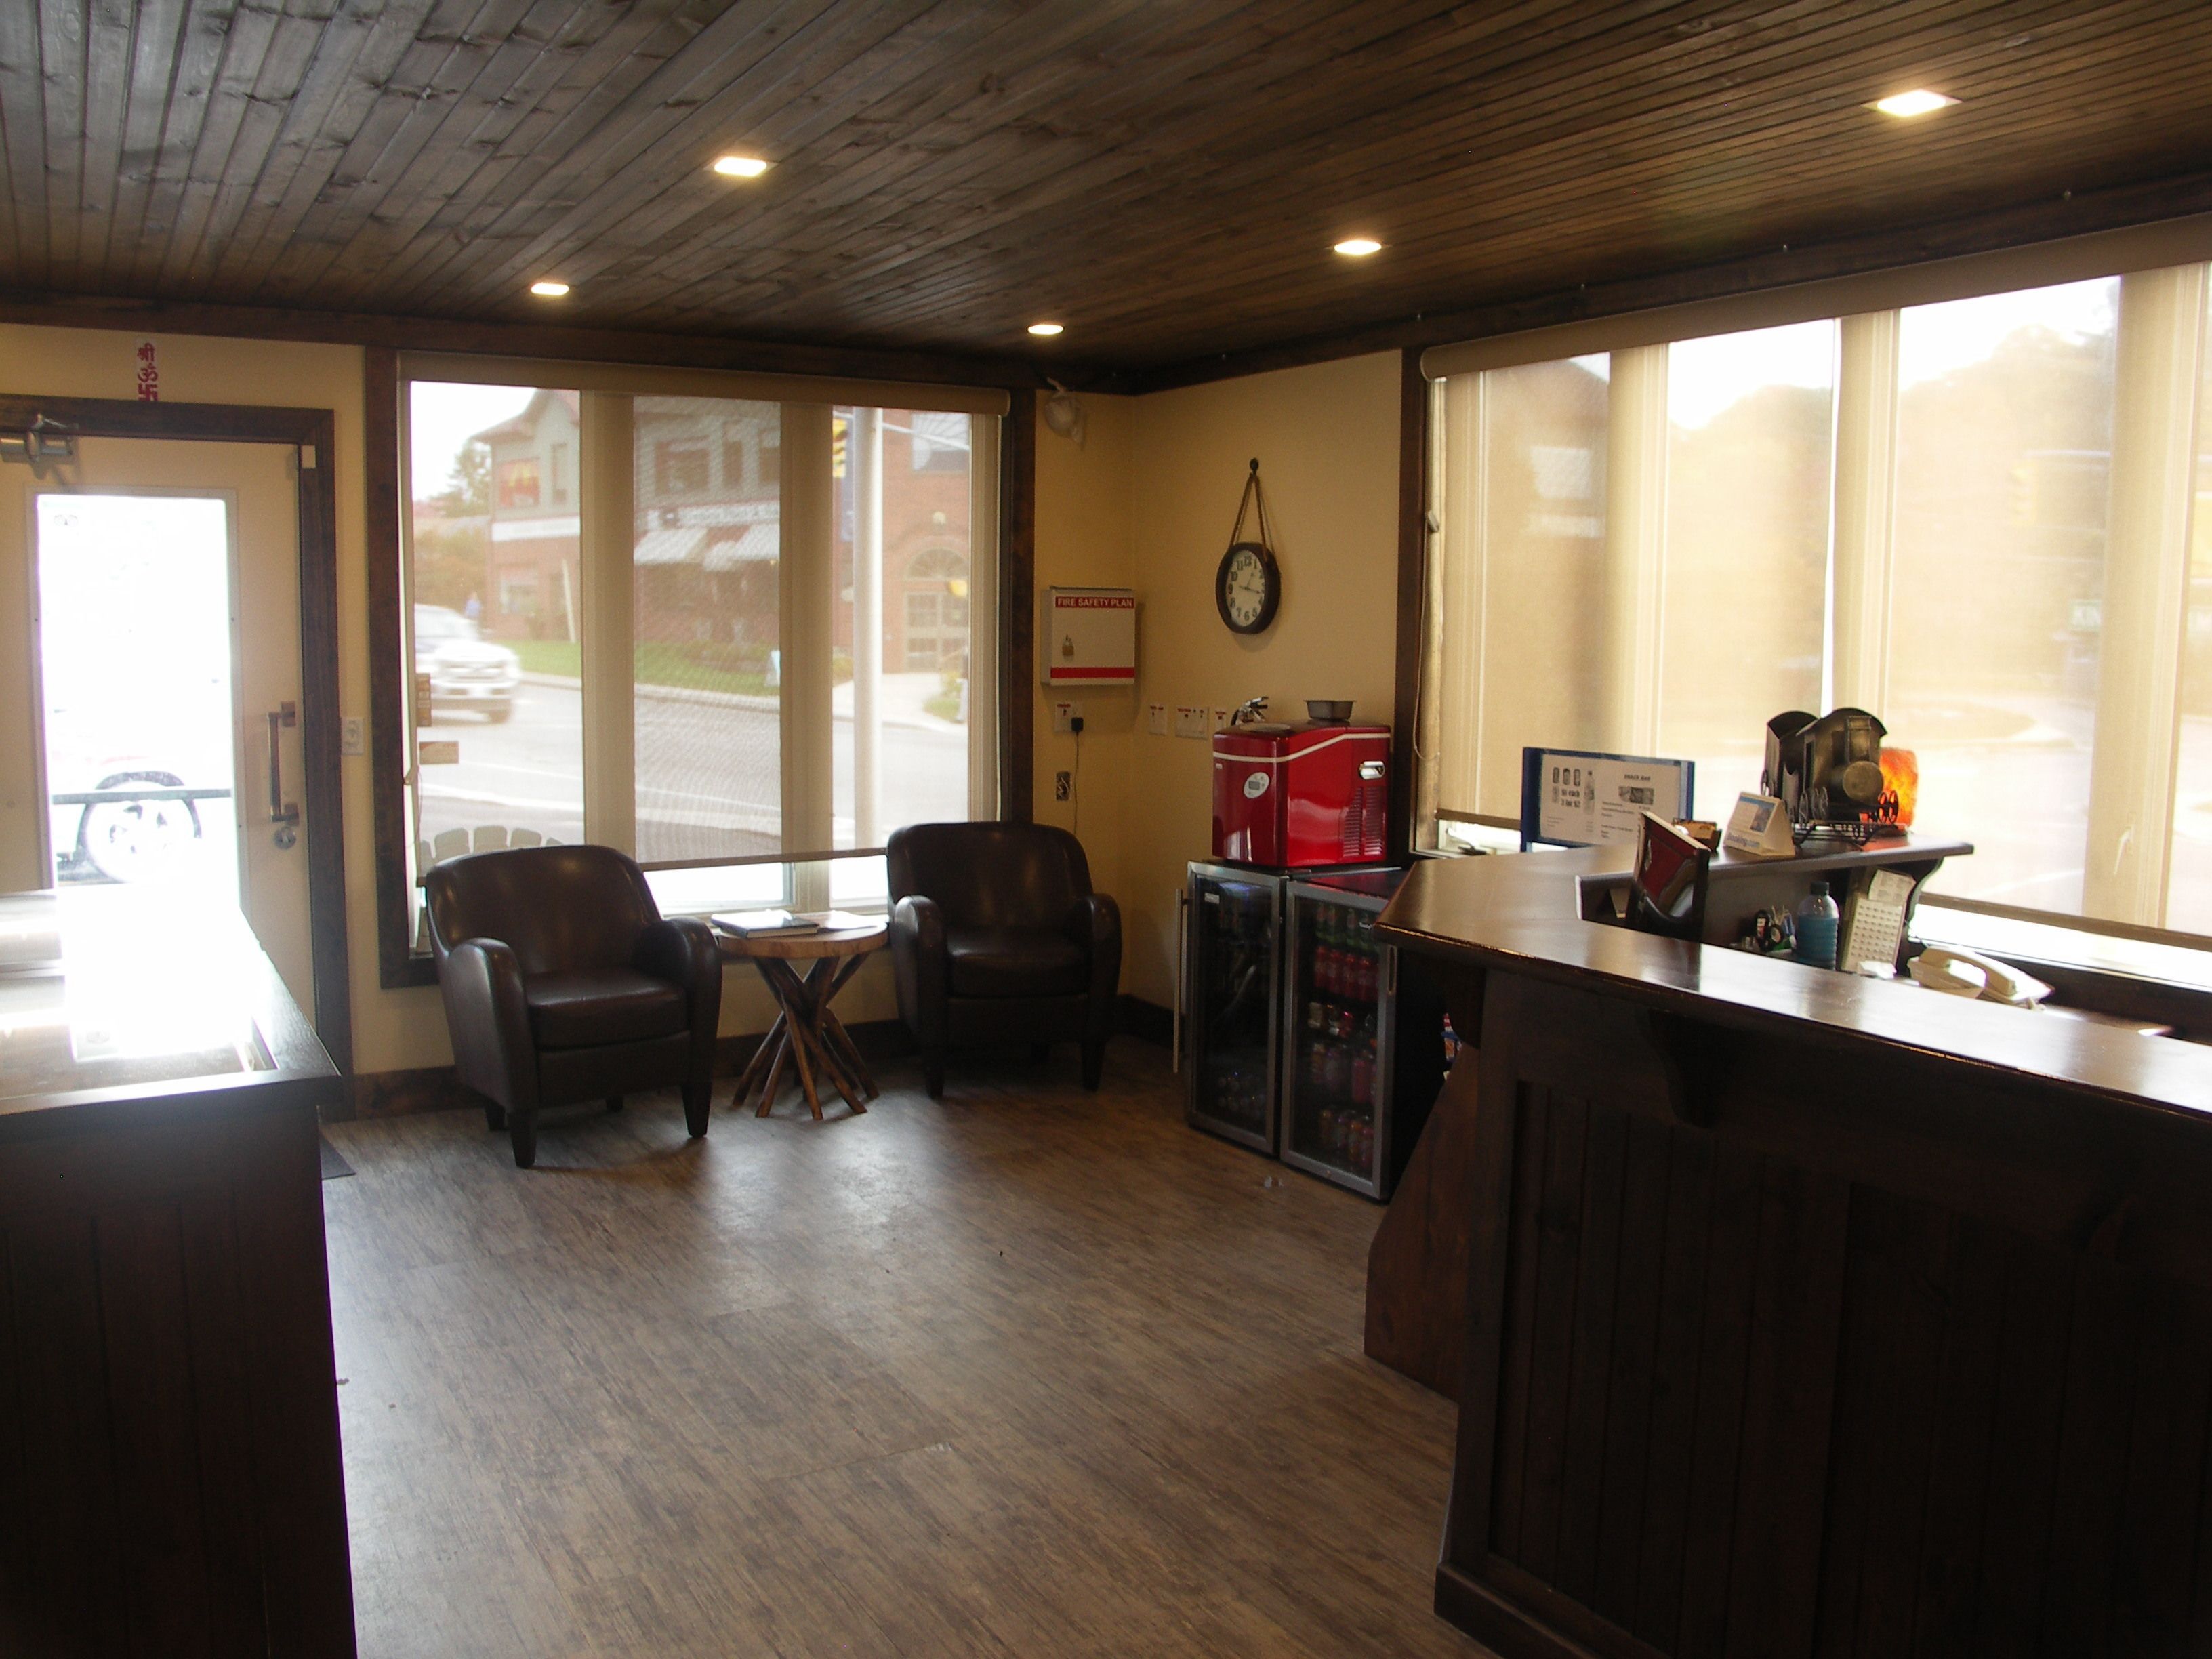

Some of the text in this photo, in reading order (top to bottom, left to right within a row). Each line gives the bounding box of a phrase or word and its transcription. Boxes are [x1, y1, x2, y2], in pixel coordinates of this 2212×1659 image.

[1057, 598, 1132, 607] FIRE SAFETY PLAN
